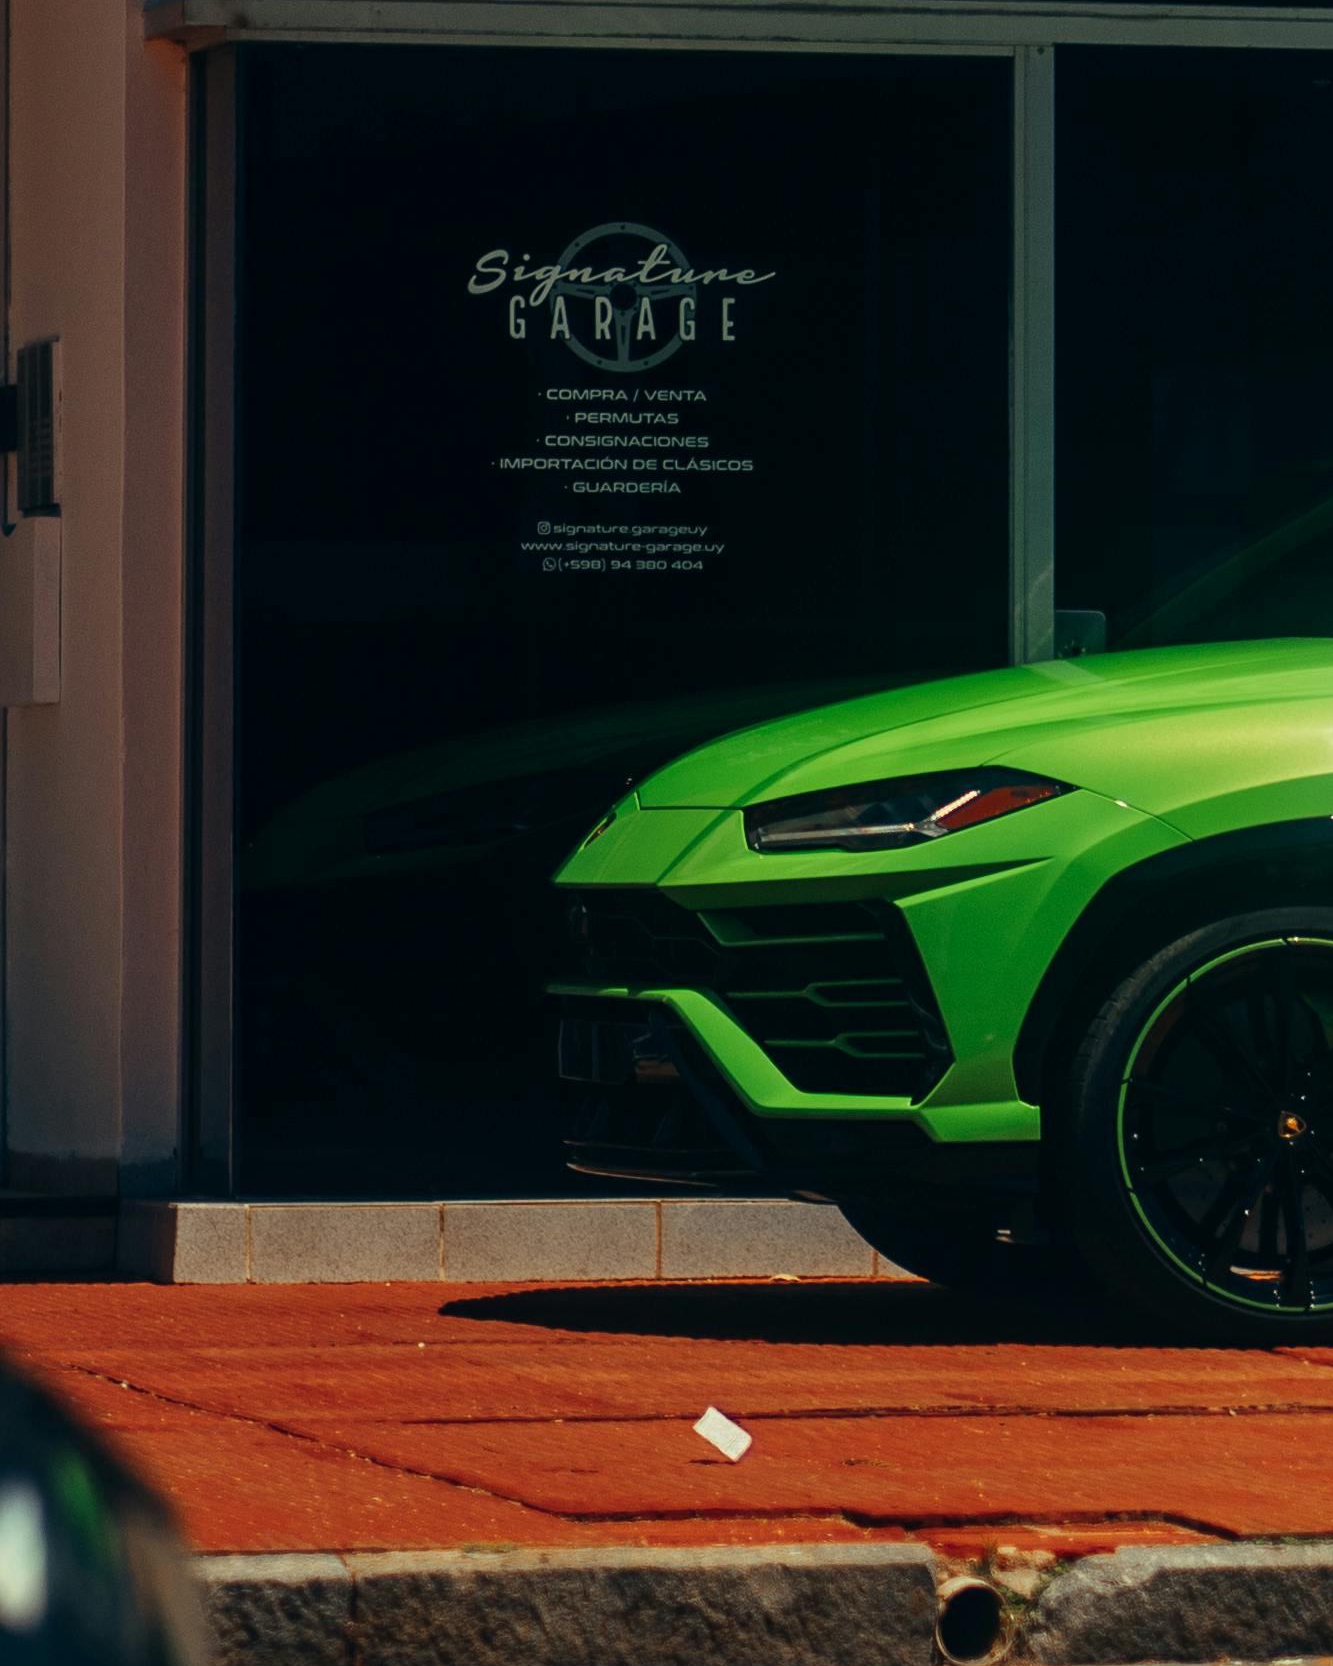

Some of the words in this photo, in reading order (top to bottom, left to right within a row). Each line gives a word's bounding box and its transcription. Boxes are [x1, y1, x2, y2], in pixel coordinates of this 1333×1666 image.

[467, 244, 776, 306] Signature
[508, 295, 736, 341] GARAGE
[546, 388, 628, 402] COMPRA
[644, 389, 707, 402] VENTA
[574, 412, 679, 425] PERMUTAS
[544, 435, 710, 449] CONSIGNACIONES
[499, 455, 627, 471] IMPORTACIÓN
[632, 458, 658, 471] DE
[662, 456, 754, 472] CLÁSICOS
[572, 479, 682, 494] GUARDERÍA
[521, 539, 725, 554] www.signature-garage.uy
[610, 560, 632, 571] 94
